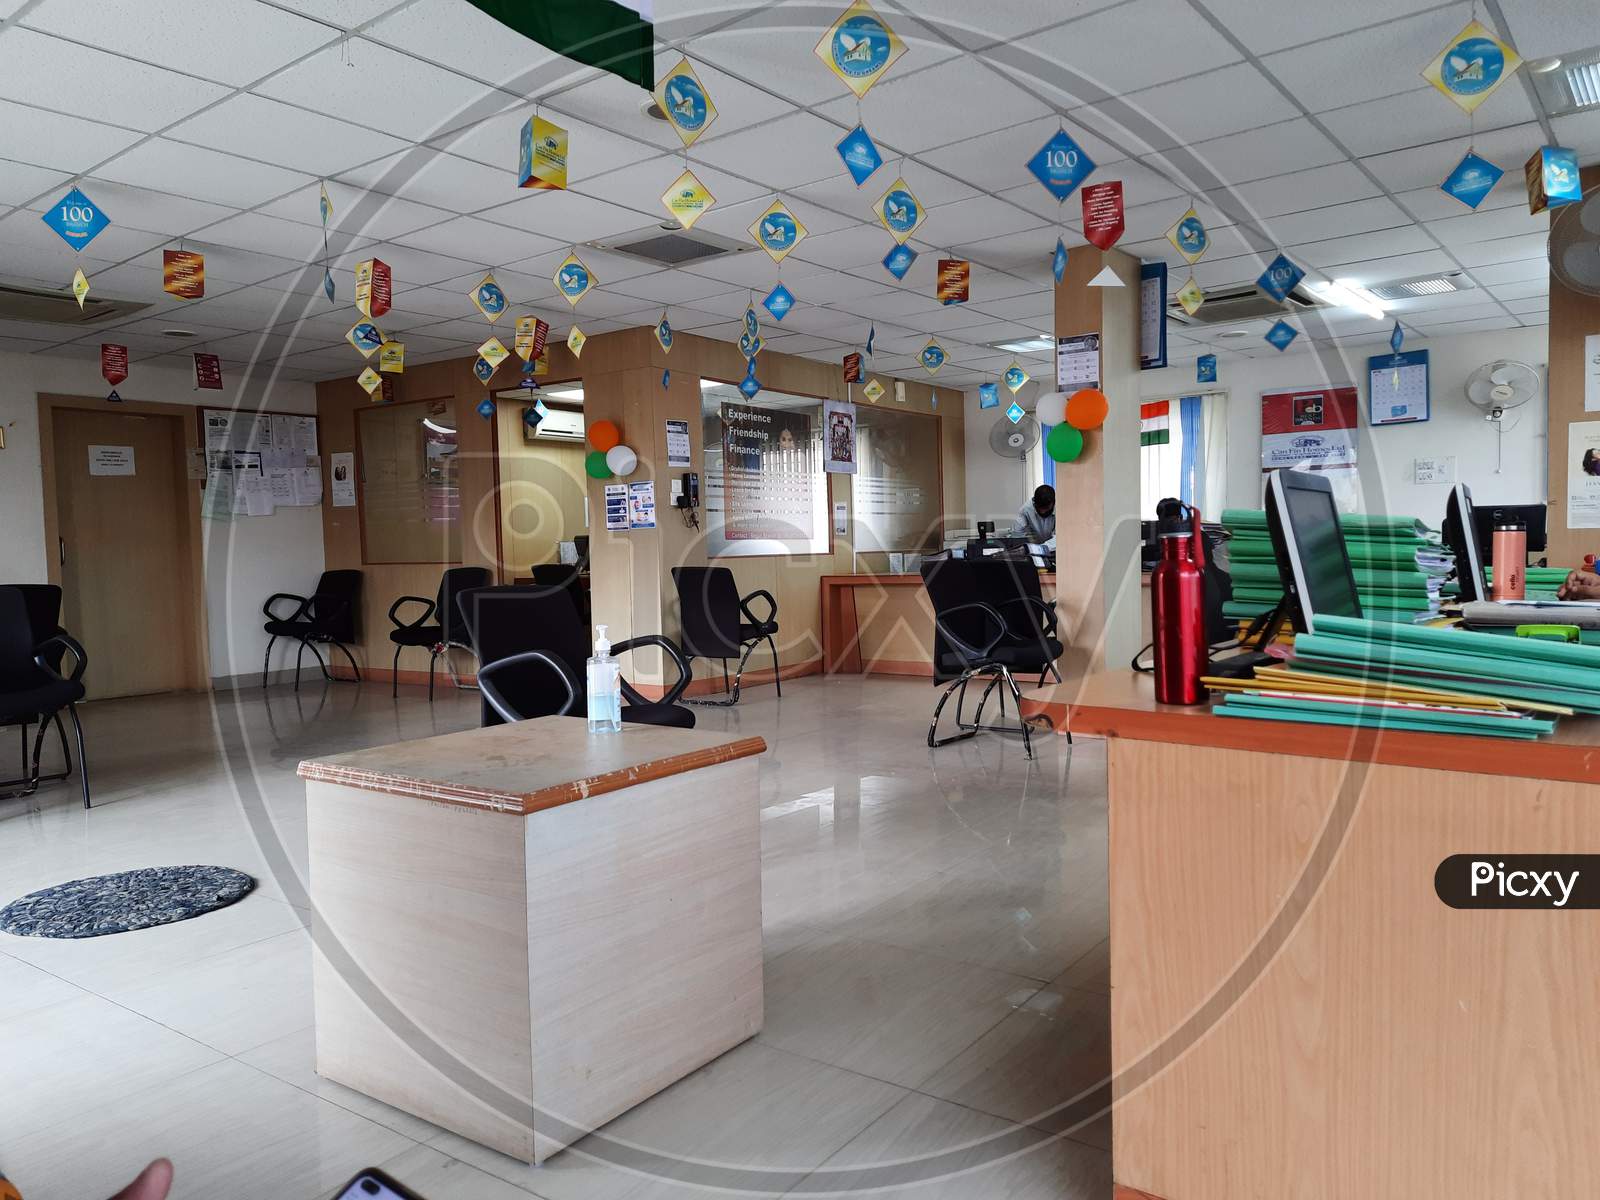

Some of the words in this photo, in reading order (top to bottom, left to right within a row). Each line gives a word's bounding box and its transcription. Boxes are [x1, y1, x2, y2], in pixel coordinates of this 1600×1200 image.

[1046, 150, 1078, 168] 100
[61, 205, 94, 223] 100
[1270, 267, 1293, 281] 100
[728, 408, 772, 423] Experience
[729, 426, 769, 441] Friendship
[729, 443, 761, 456] Finance
